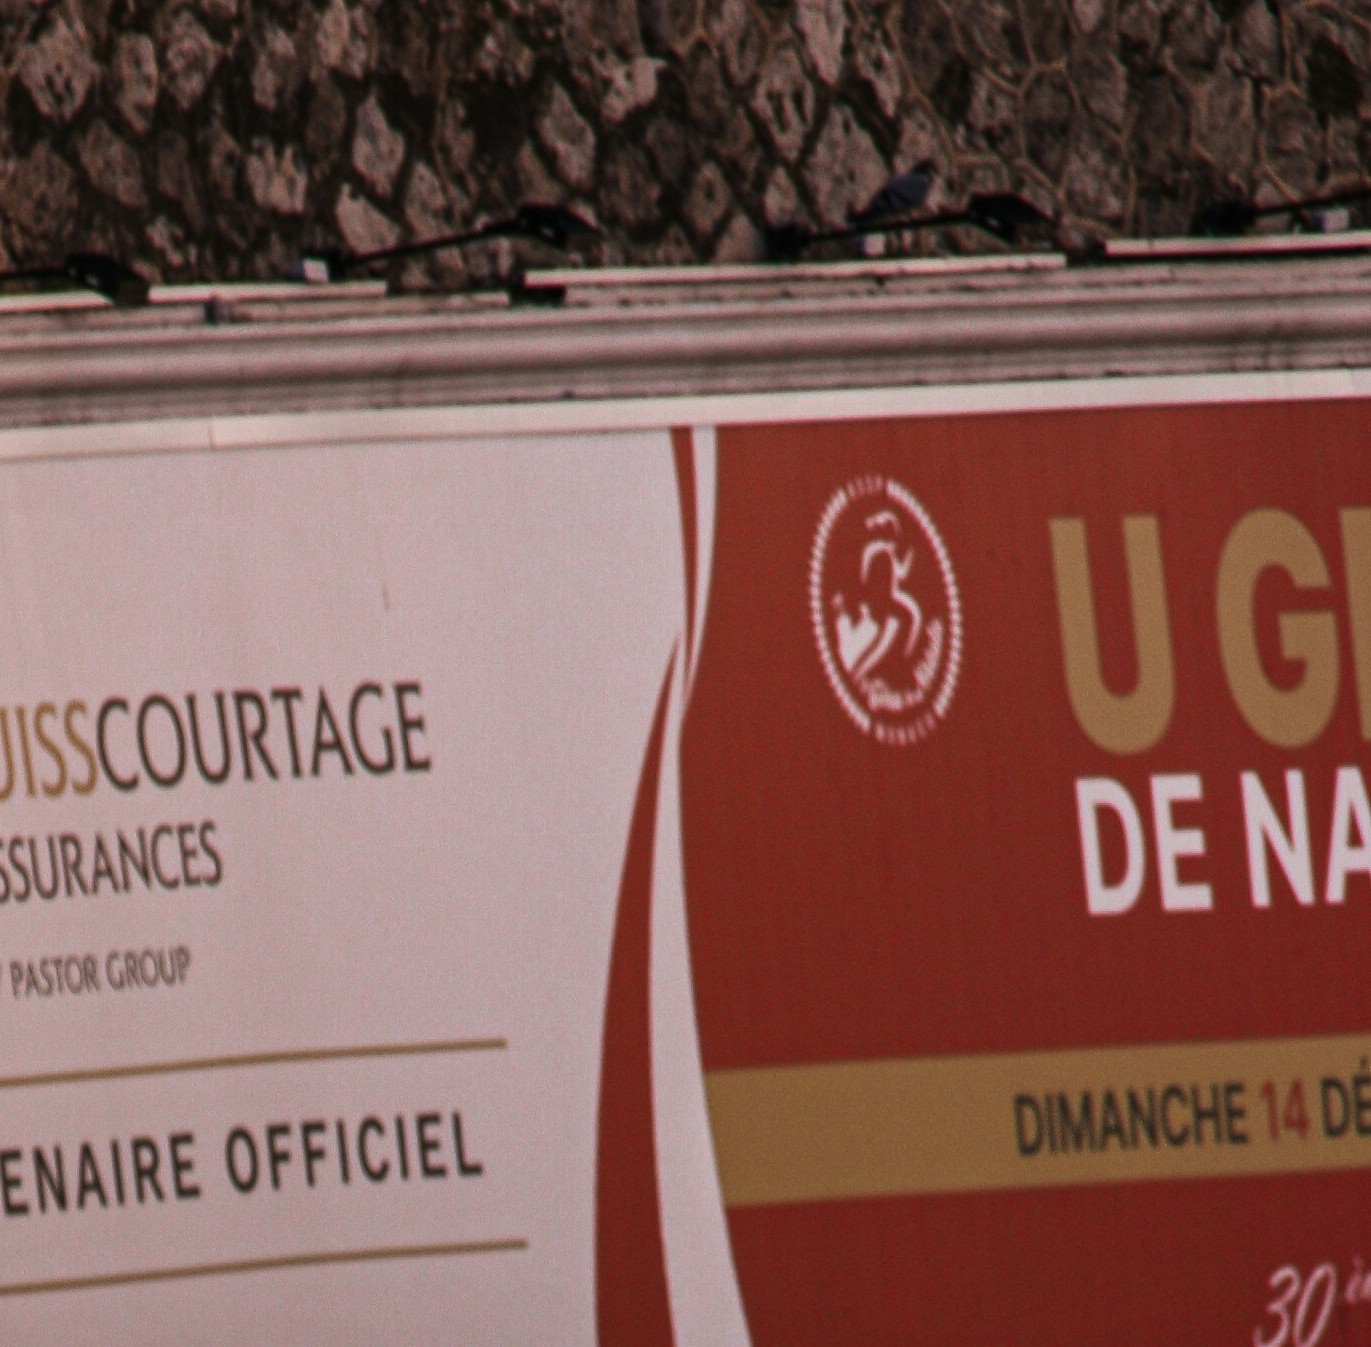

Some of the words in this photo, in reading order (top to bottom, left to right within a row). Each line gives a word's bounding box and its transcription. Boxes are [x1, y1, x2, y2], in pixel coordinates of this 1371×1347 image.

[1047, 514, 1177, 756] U
[1075, 772, 1214, 917] DE
[10, 953, 100, 999] PASTOR
[106, 944, 191, 993] GROUP
[226, 1110, 483, 1194] OFFICIEL
[1014, 1082, 1249, 1157] DIMANCHE
[1261, 1077, 1310, 1140] 14
